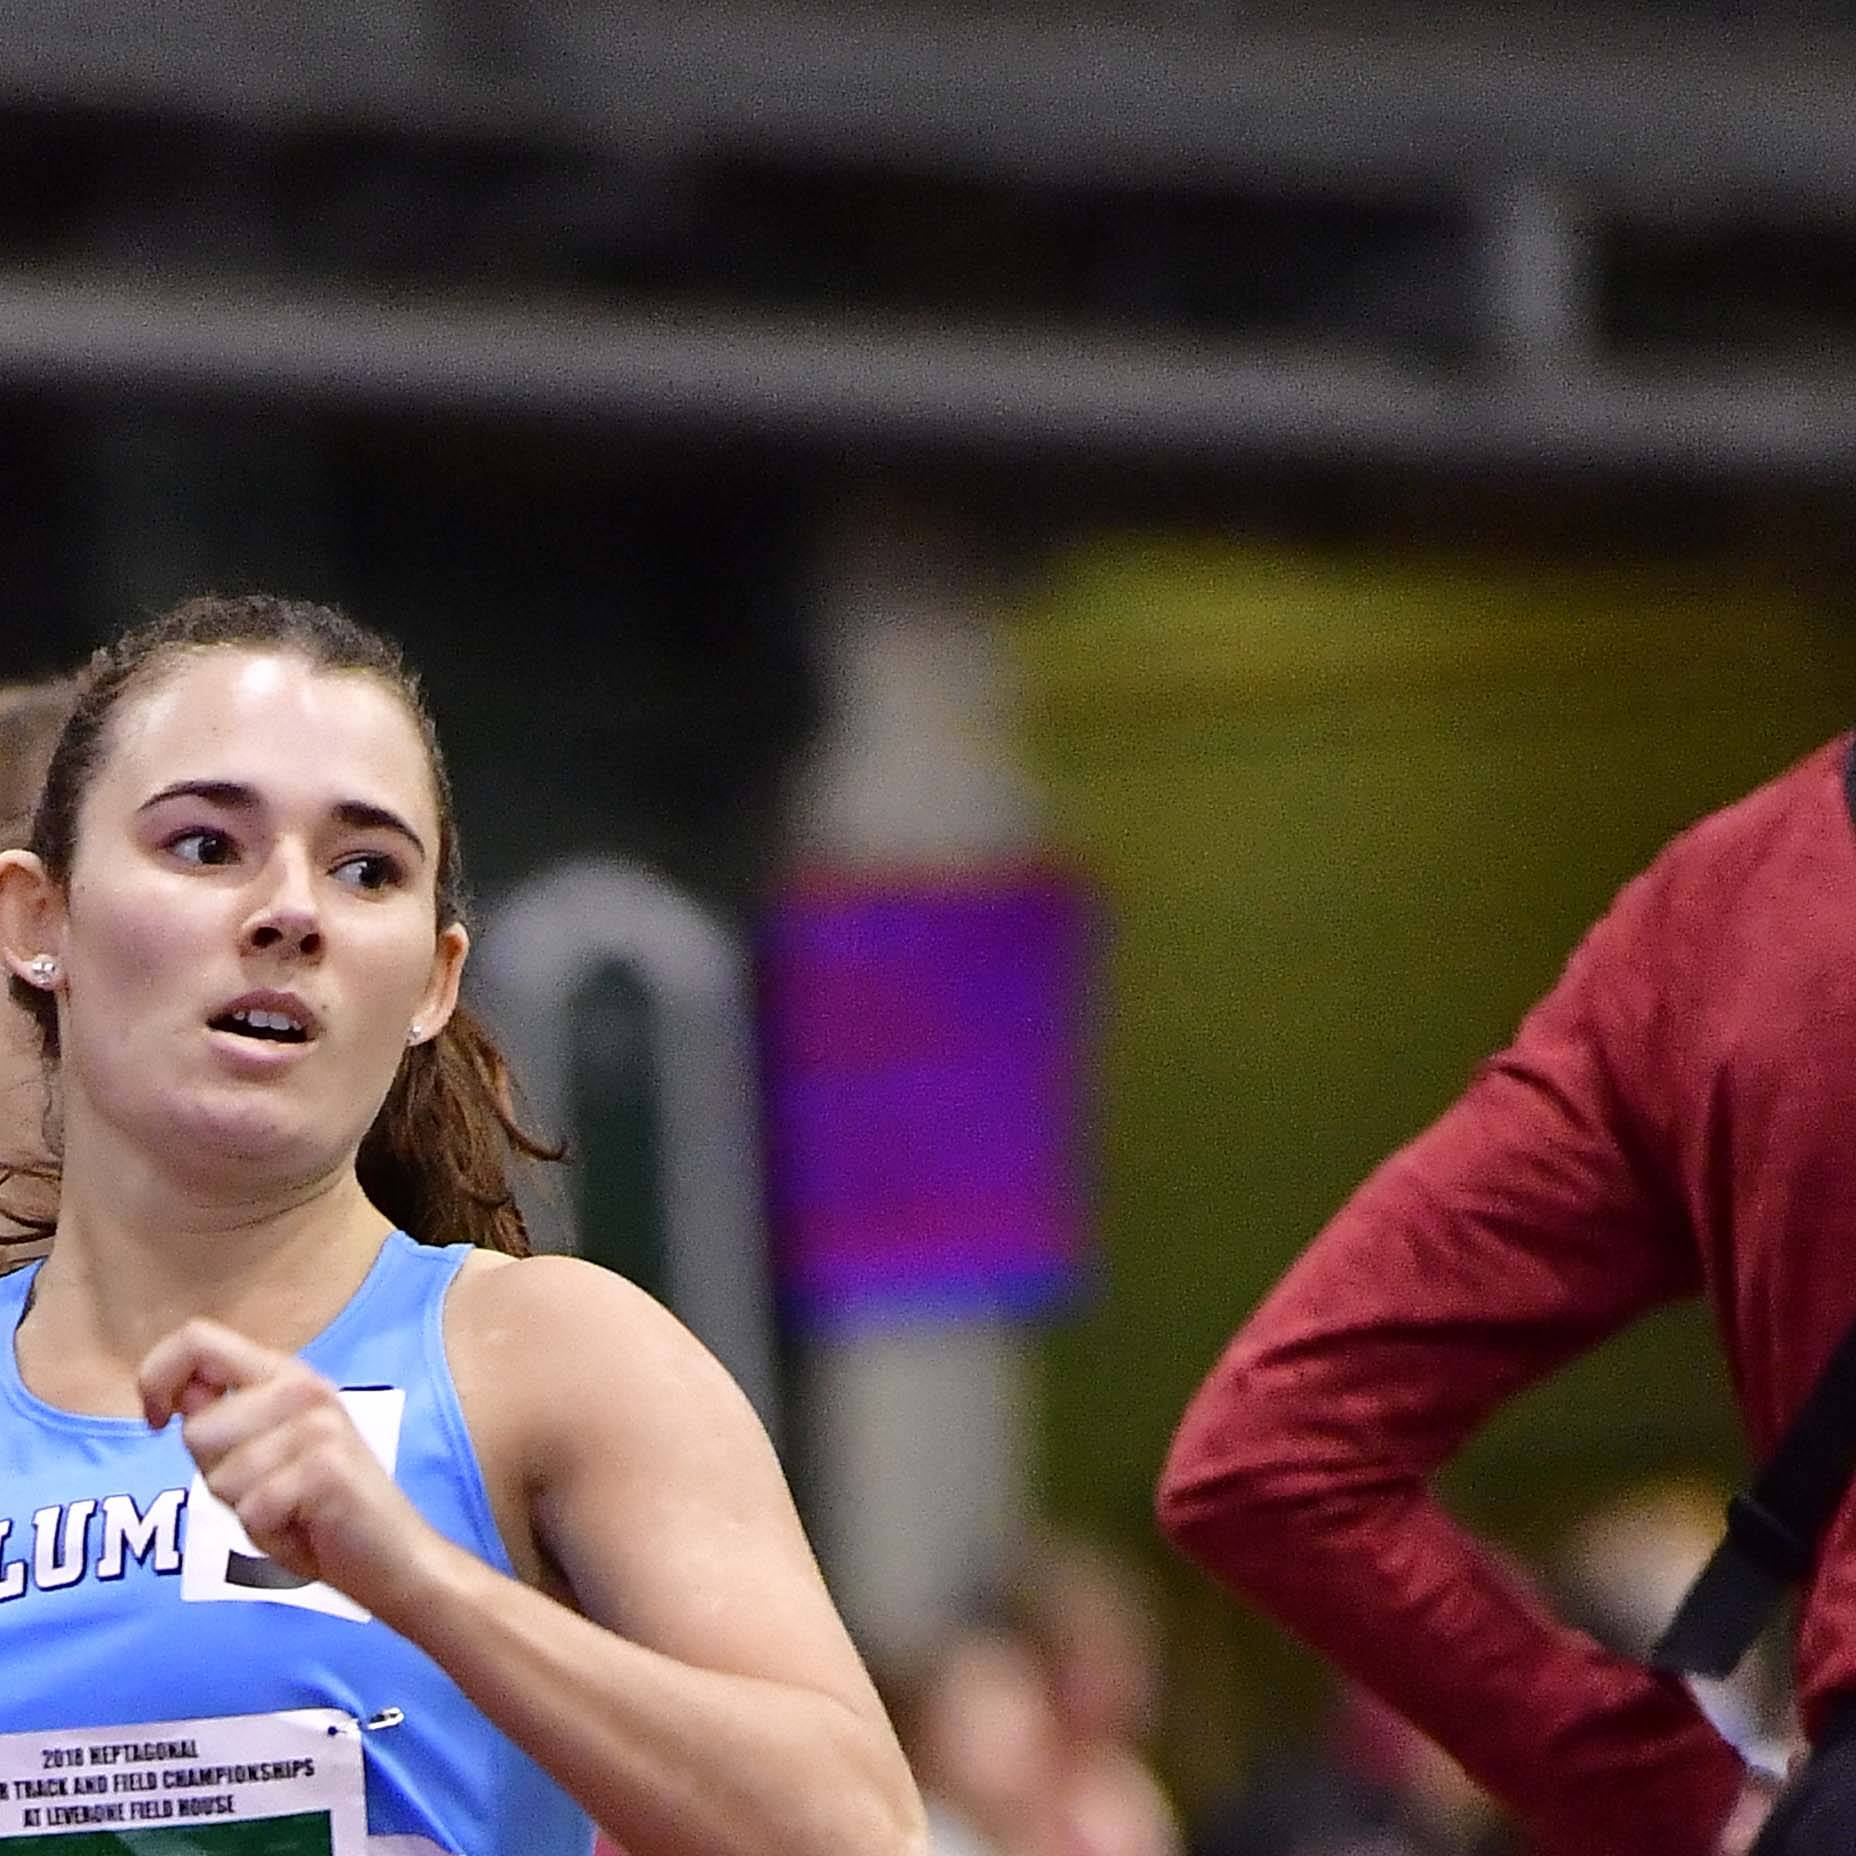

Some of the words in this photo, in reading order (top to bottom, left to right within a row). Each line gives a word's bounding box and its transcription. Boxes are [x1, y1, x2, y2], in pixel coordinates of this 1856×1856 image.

[42, 1747, 84, 1769] 2018
[89, 1739, 199, 1766] HEPTAGONAL
[13, 1777, 69, 1799] TRACK
[73, 1774, 108, 1795] AND
[113, 1770, 158, 1793] FIELD
[162, 1758, 315, 1789] CHAMPIONSHIPS
[23, 1808, 42, 1828] AT
[130, 1799, 174, 1820] FIELD
[178, 1794, 236, 1817] HOUSE
